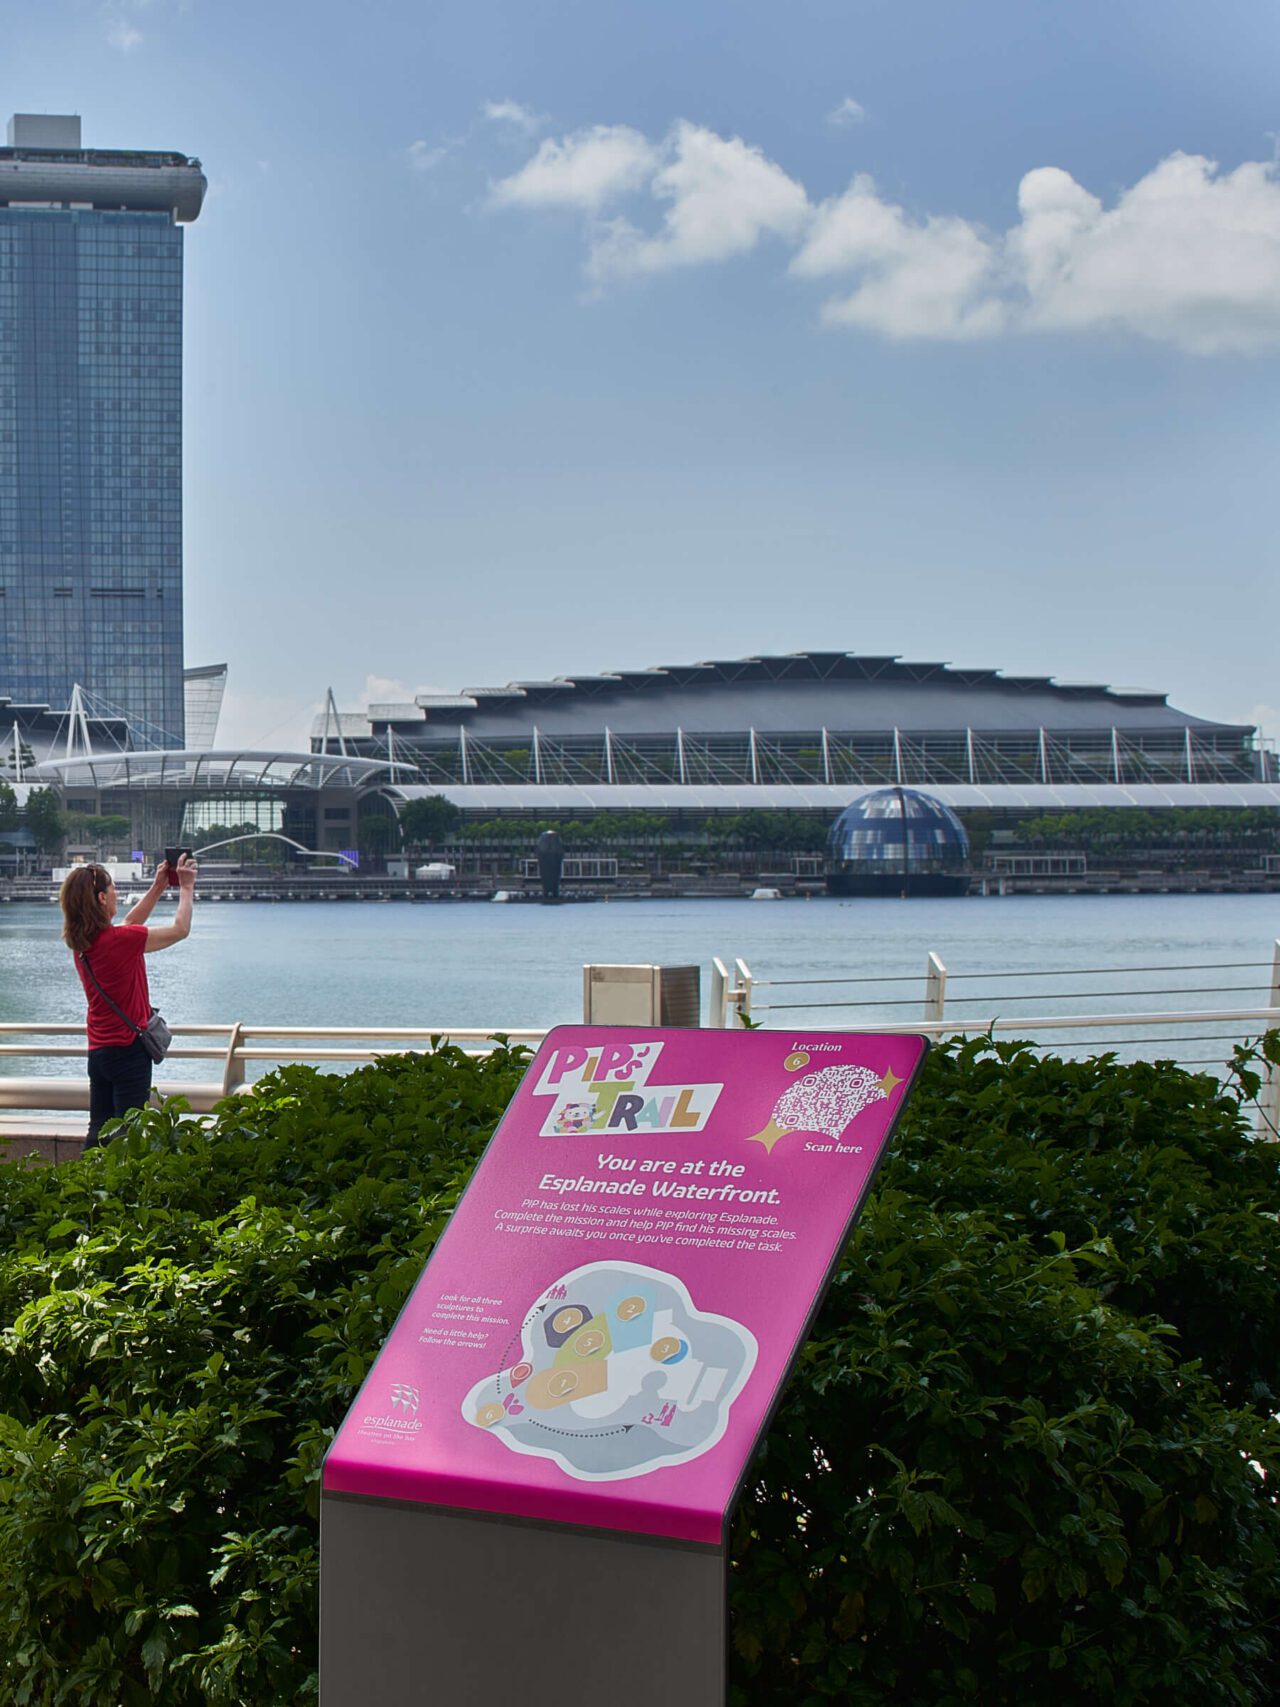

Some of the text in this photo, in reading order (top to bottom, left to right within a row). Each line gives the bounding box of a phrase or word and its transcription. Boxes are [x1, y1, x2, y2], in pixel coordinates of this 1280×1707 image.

[791, 1042, 842, 1052] Location
[793, 1056, 801, 1066] 6
[588, 1081, 701, 1131] TRAIL
[803, 1141, 862, 1154] Scan here
[597, 1154, 745, 1177] You are at the
[538, 1174, 781, 1204] Esplanade Waterfront.
[521, 1199, 779, 1225] PIP has lost his scales while exploring Esplanade.
[494, 1209, 797, 1240] Complete the mission and help PIP find his missing scales.
[494, 1222, 783, 1252] A surprise awaits you once you've completed the task.
[459, 1294, 470, 1302] for
[482, 1297, 503, 1306] three
[436, 1303, 475, 1312] sculptures
[626, 1304, 636, 1313] 2
[431, 1311, 510, 1325] complete this mission.
[563, 1316, 572, 1326] 4
[423, 1327, 443, 1335] Need
[449, 1330, 468, 1338] little
[467, 1332, 489, 1340] help?
[418, 1335, 487, 1349] Follow the arrows!
[583, 1337, 593, 1347] 5
[660, 1344, 670, 1353] 3
[560, 1379, 567, 1388] 1
[486, 1409, 493, 1420] 6
[363, 1415, 423, 1430] esplanade
